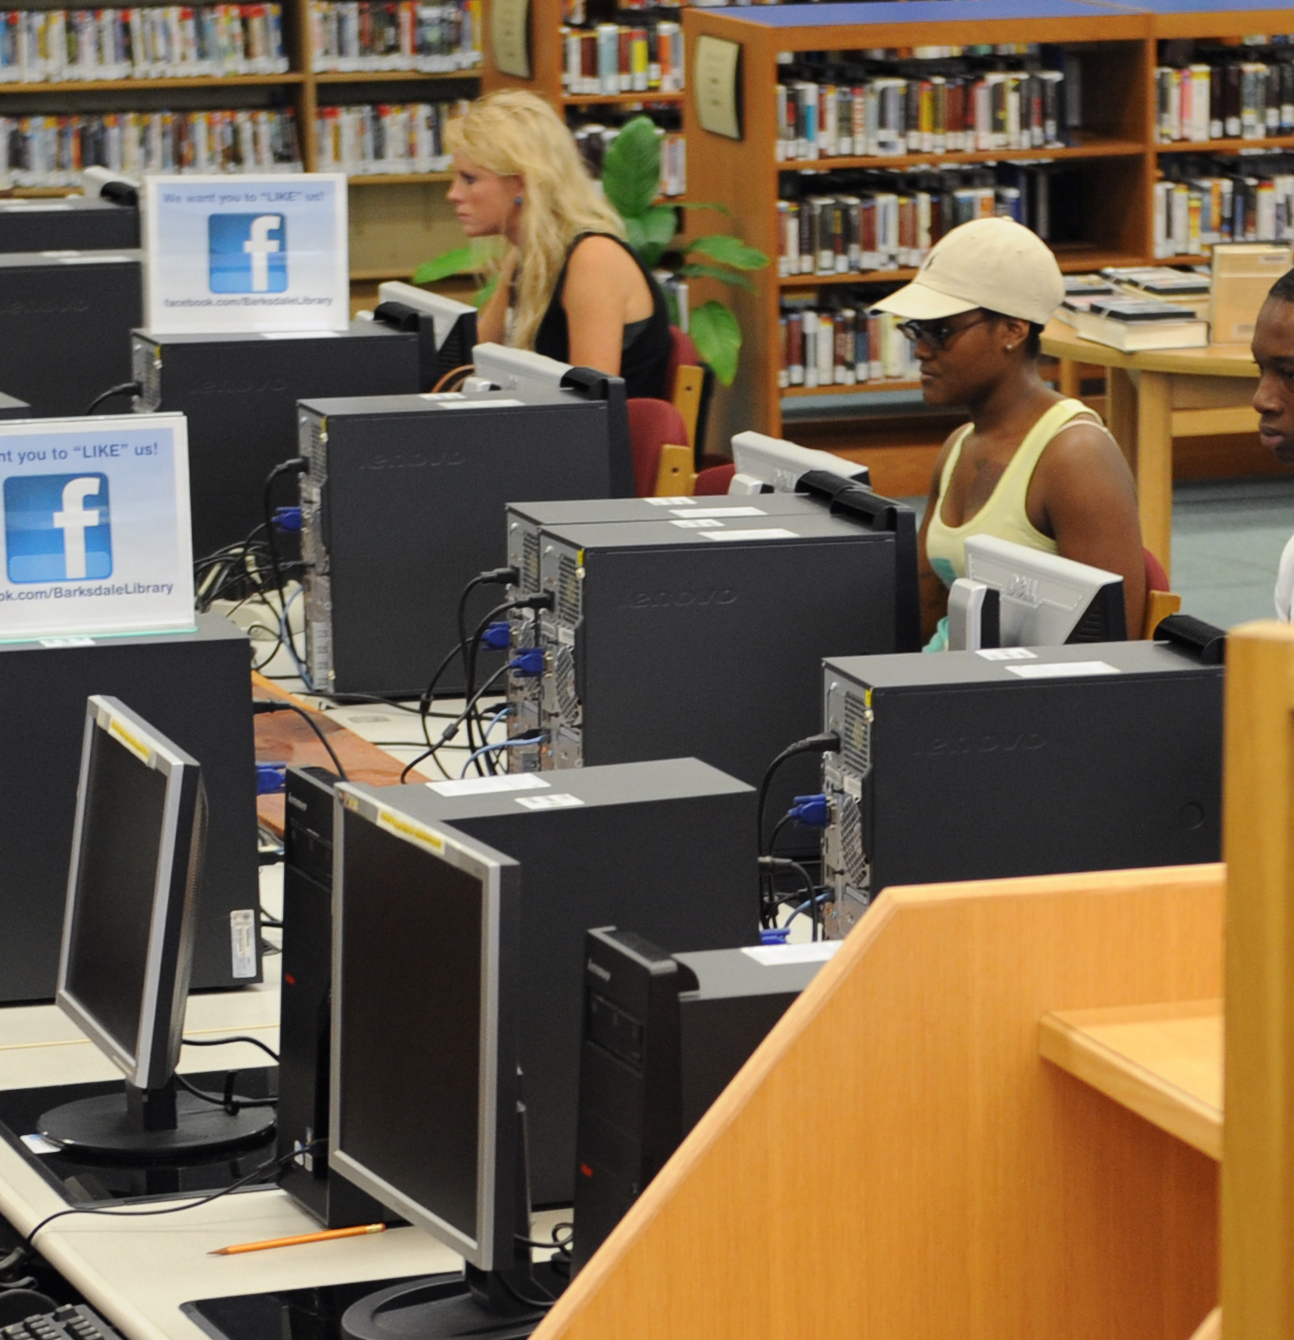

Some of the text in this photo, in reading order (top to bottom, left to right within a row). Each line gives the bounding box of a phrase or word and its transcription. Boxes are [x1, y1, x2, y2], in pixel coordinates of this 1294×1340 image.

[163, 194, 182, 204] We
[187, 193, 215, 204] want
[219, 193, 241, 205] you
[245, 191, 257, 202] to
[305, 191, 325, 202] us!
[163, 297, 334, 308] facebook.com/BarksdaleLibrary
[17, 450, 47, 466] you
[52, 448, 68, 460] to
[134, 442, 159, 457] us!
